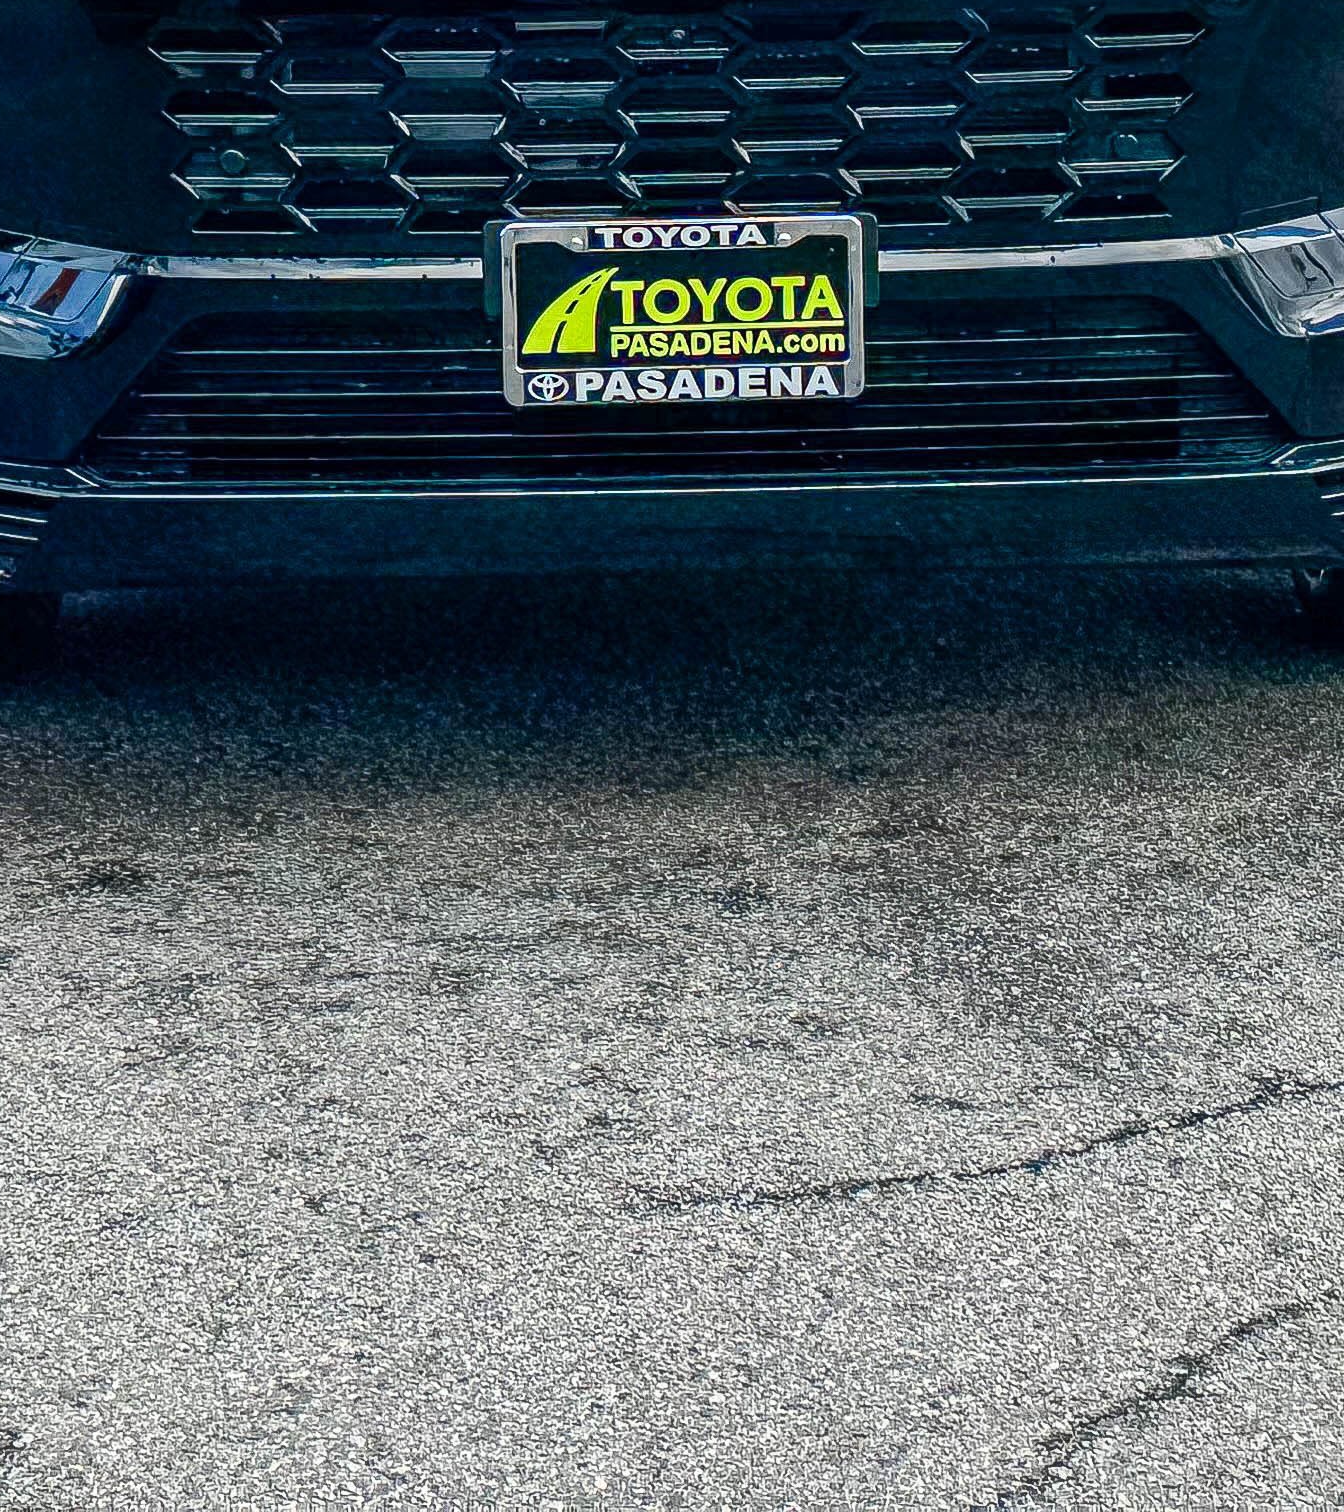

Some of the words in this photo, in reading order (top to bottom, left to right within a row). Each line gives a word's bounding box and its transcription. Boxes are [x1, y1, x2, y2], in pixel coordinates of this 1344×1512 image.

[594, 225, 766, 248] TOYOTA
[611, 275, 844, 324] TOYOTA
[611, 331, 845, 358] PASADENA.com
[575, 366, 839, 402] PASADENA
